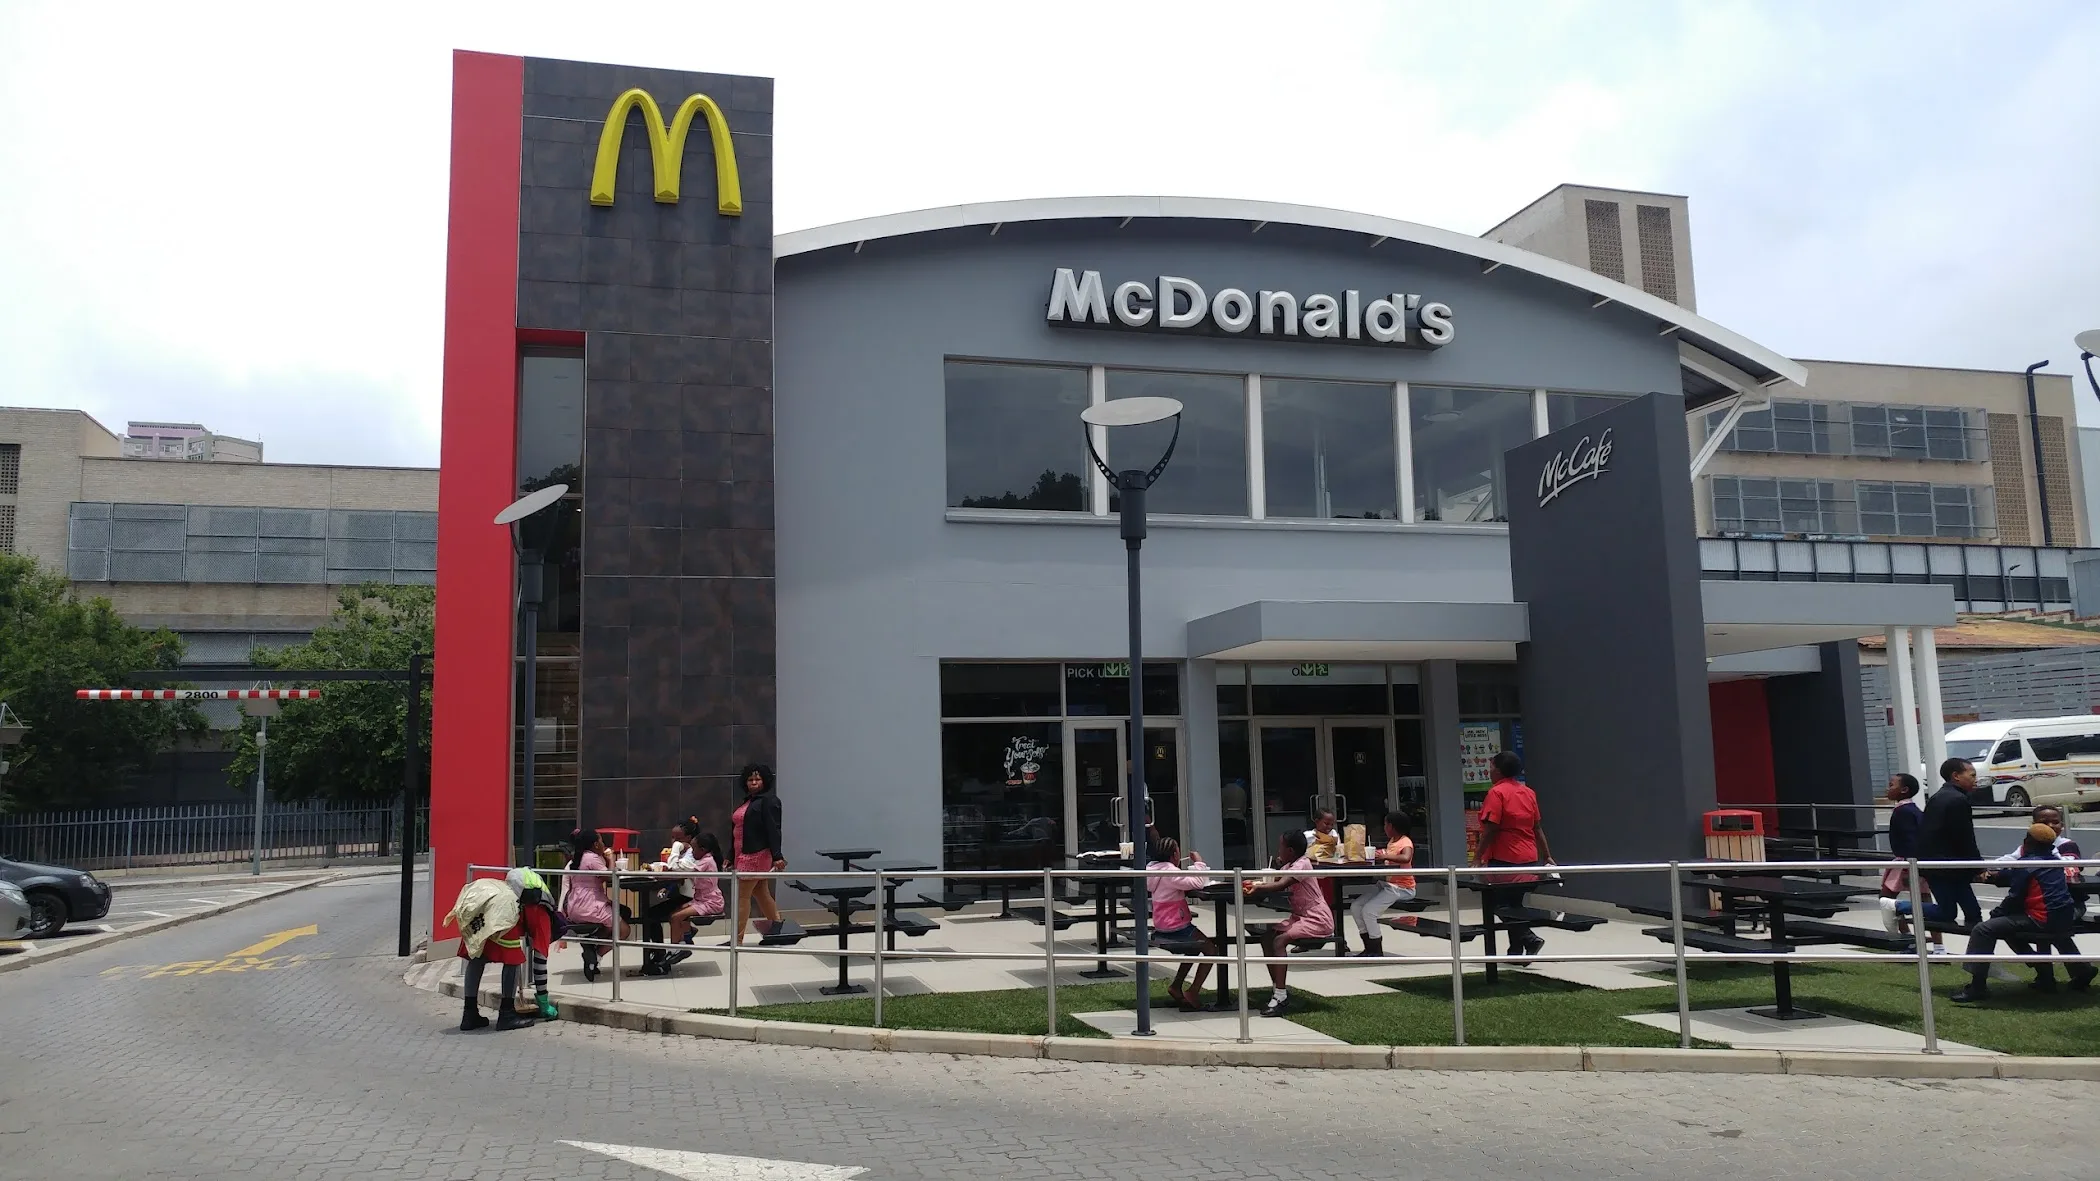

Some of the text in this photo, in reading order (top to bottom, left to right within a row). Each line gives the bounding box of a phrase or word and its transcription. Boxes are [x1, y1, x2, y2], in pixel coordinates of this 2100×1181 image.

[1046, 267, 1455, 345] McDonald's
[1538, 427, 1612, 507] McCafé
[185, 691, 218, 699] 2800
[1067, 668, 1095, 678] PICK
